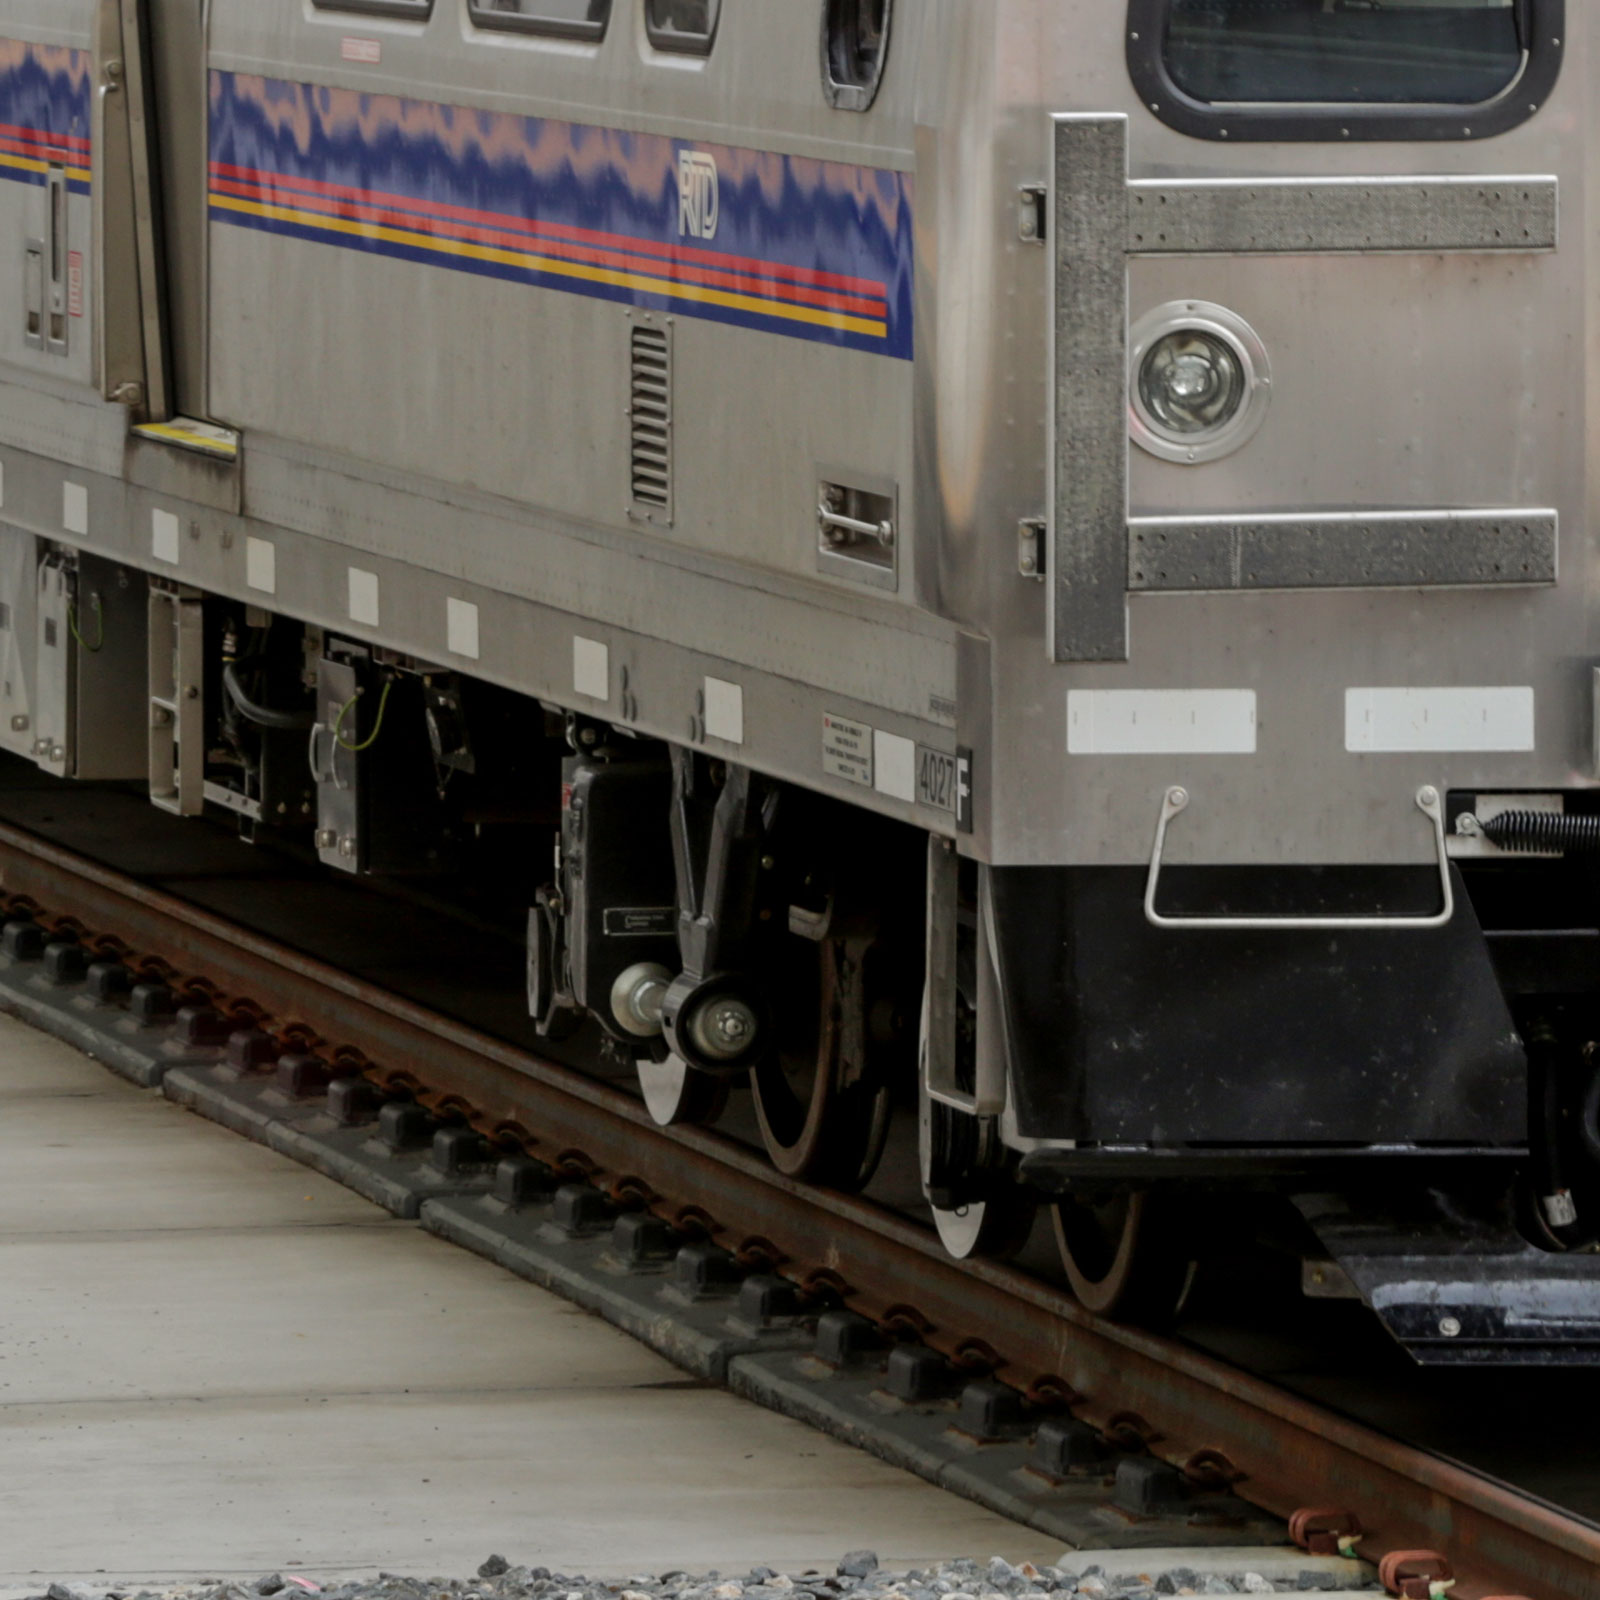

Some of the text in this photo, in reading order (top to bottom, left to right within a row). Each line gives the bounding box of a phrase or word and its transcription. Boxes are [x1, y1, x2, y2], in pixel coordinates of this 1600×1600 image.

[678, 149, 719, 240] RTD
[919, 750, 955, 809] 4027
[956, 757, 970, 822] F
